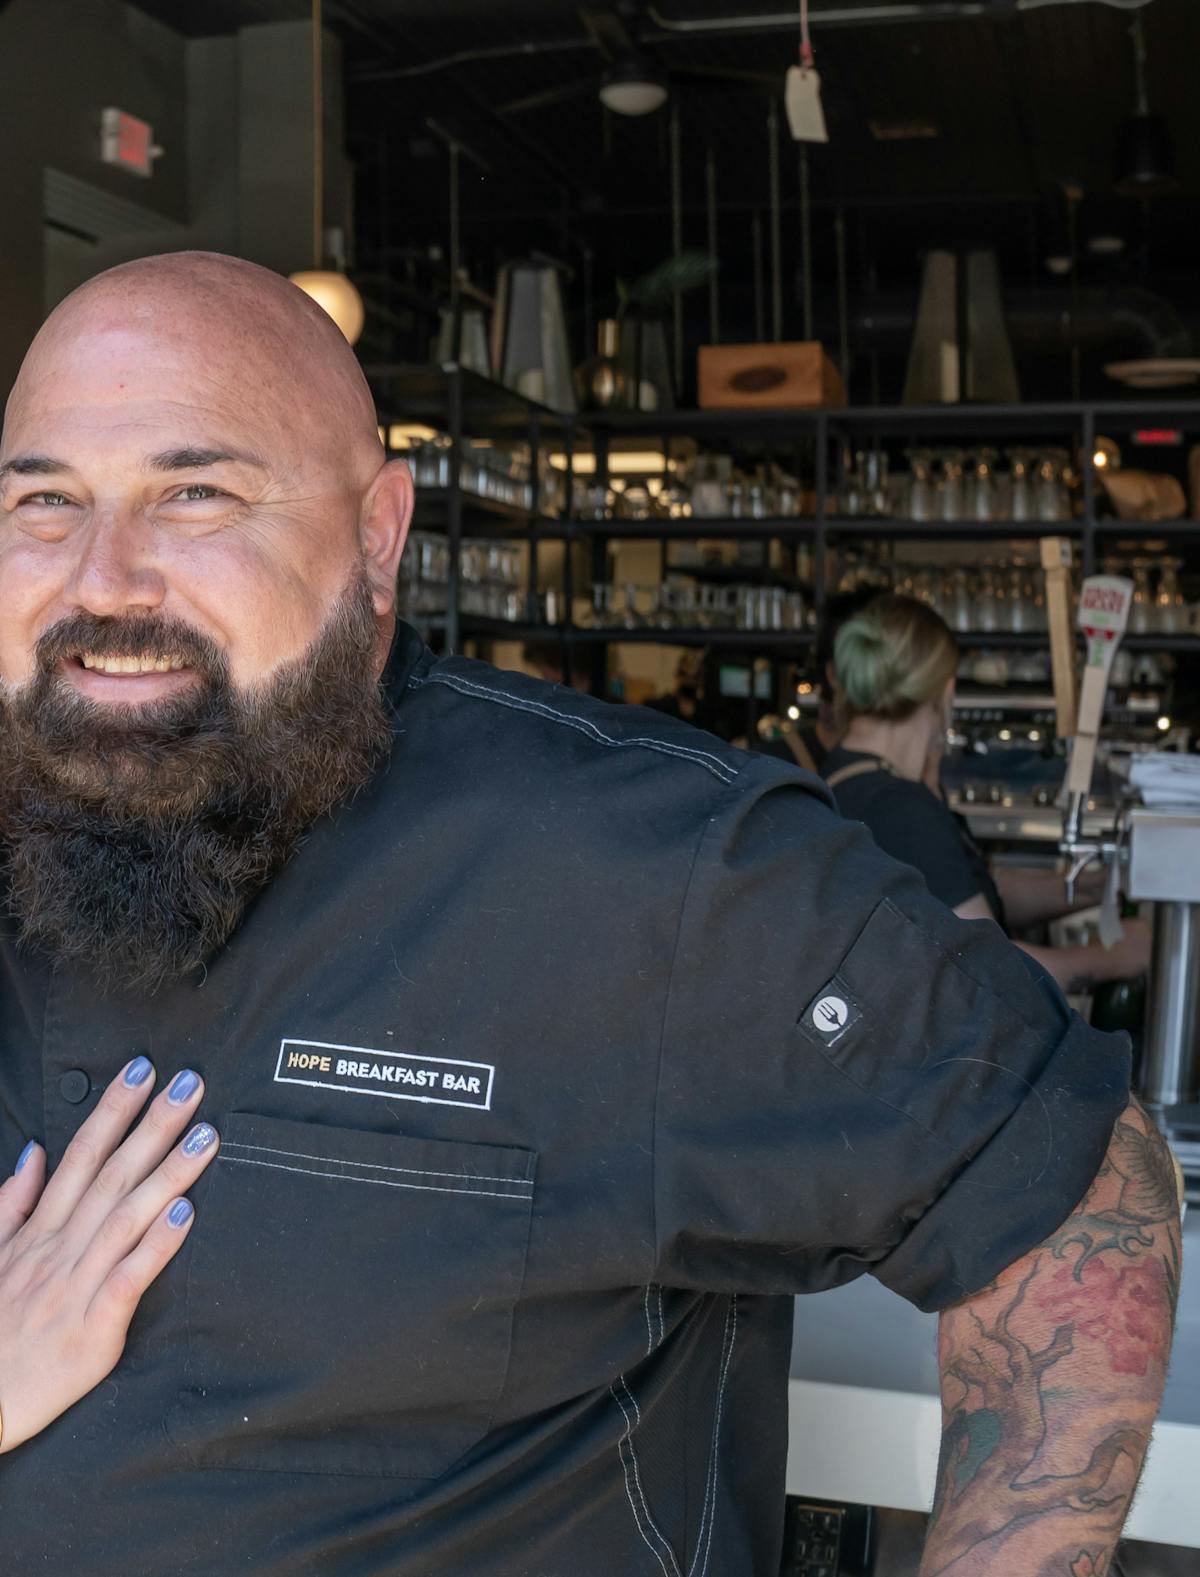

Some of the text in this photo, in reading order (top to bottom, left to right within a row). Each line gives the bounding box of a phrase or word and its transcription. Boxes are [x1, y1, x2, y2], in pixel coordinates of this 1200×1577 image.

[287, 1051, 481, 1094] HOPE BREAKFAST BAR
